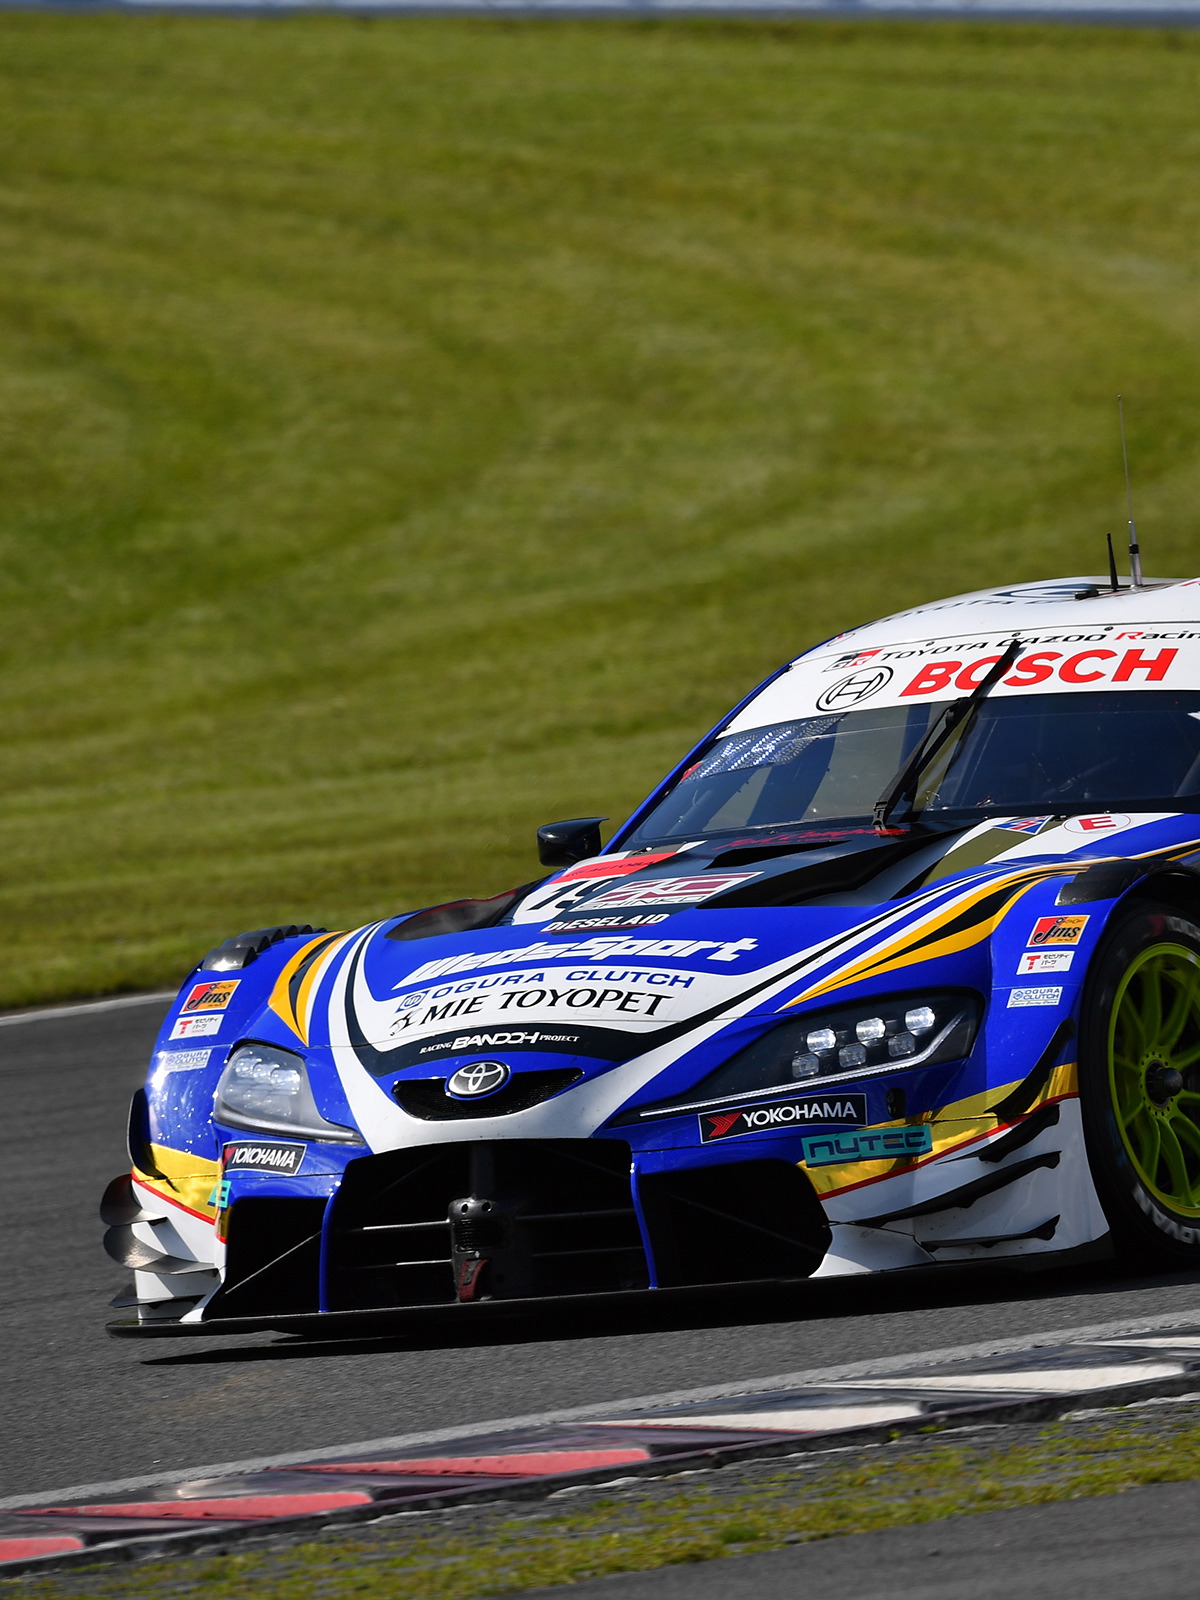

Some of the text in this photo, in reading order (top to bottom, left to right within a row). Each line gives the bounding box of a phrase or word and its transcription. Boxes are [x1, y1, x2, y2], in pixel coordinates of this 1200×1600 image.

[881, 642, 988, 662] TOYOTA
[996, 633, 1107, 649] GAZOO
[898, 648, 1179, 697] BOSCH
[432, 970, 695, 999] OGURA CLUTCH
[420, 988, 674, 1026] MIE TOYOPET
[419, 1040, 453, 1054] RACING
[539, 1034, 580, 1044] PROJECT
[741, 1101, 859, 1127] YOKOHAMA
[232, 1147, 296, 1168] YOKOHAMA
